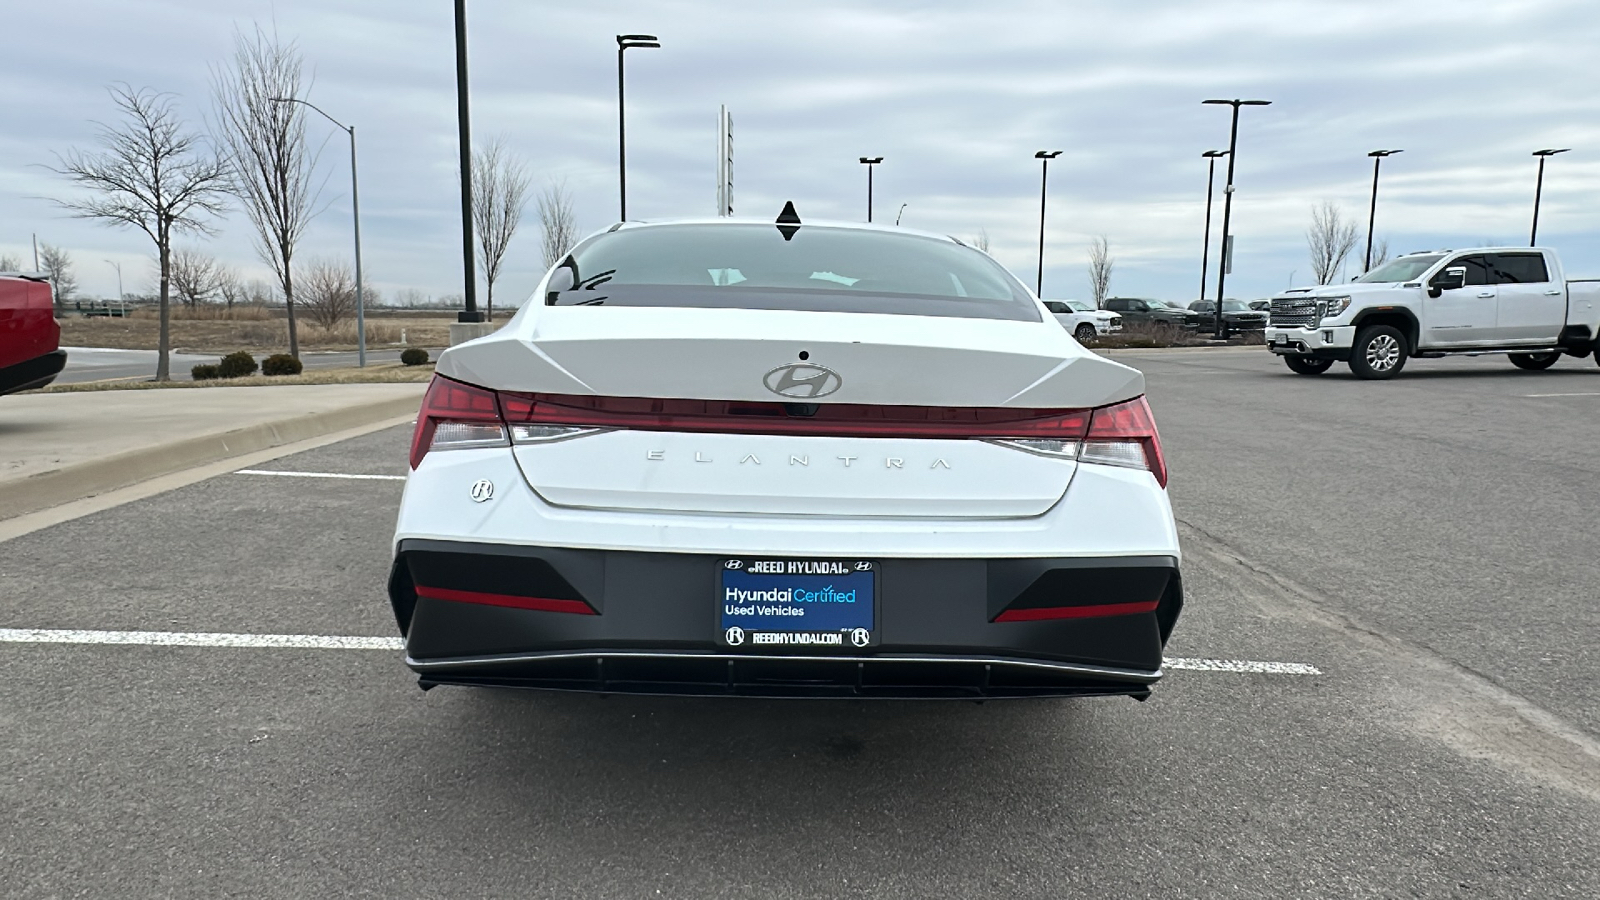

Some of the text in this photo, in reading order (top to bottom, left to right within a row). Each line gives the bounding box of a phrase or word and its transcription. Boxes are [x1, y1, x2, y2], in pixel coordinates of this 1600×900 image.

[646, 449, 952, 470] ELANTRA
[754, 560, 843, 575] REED HYUNDAI
[726, 586, 856, 604] Hyundai Certified
[725, 605, 805, 616] Used Vehicles
